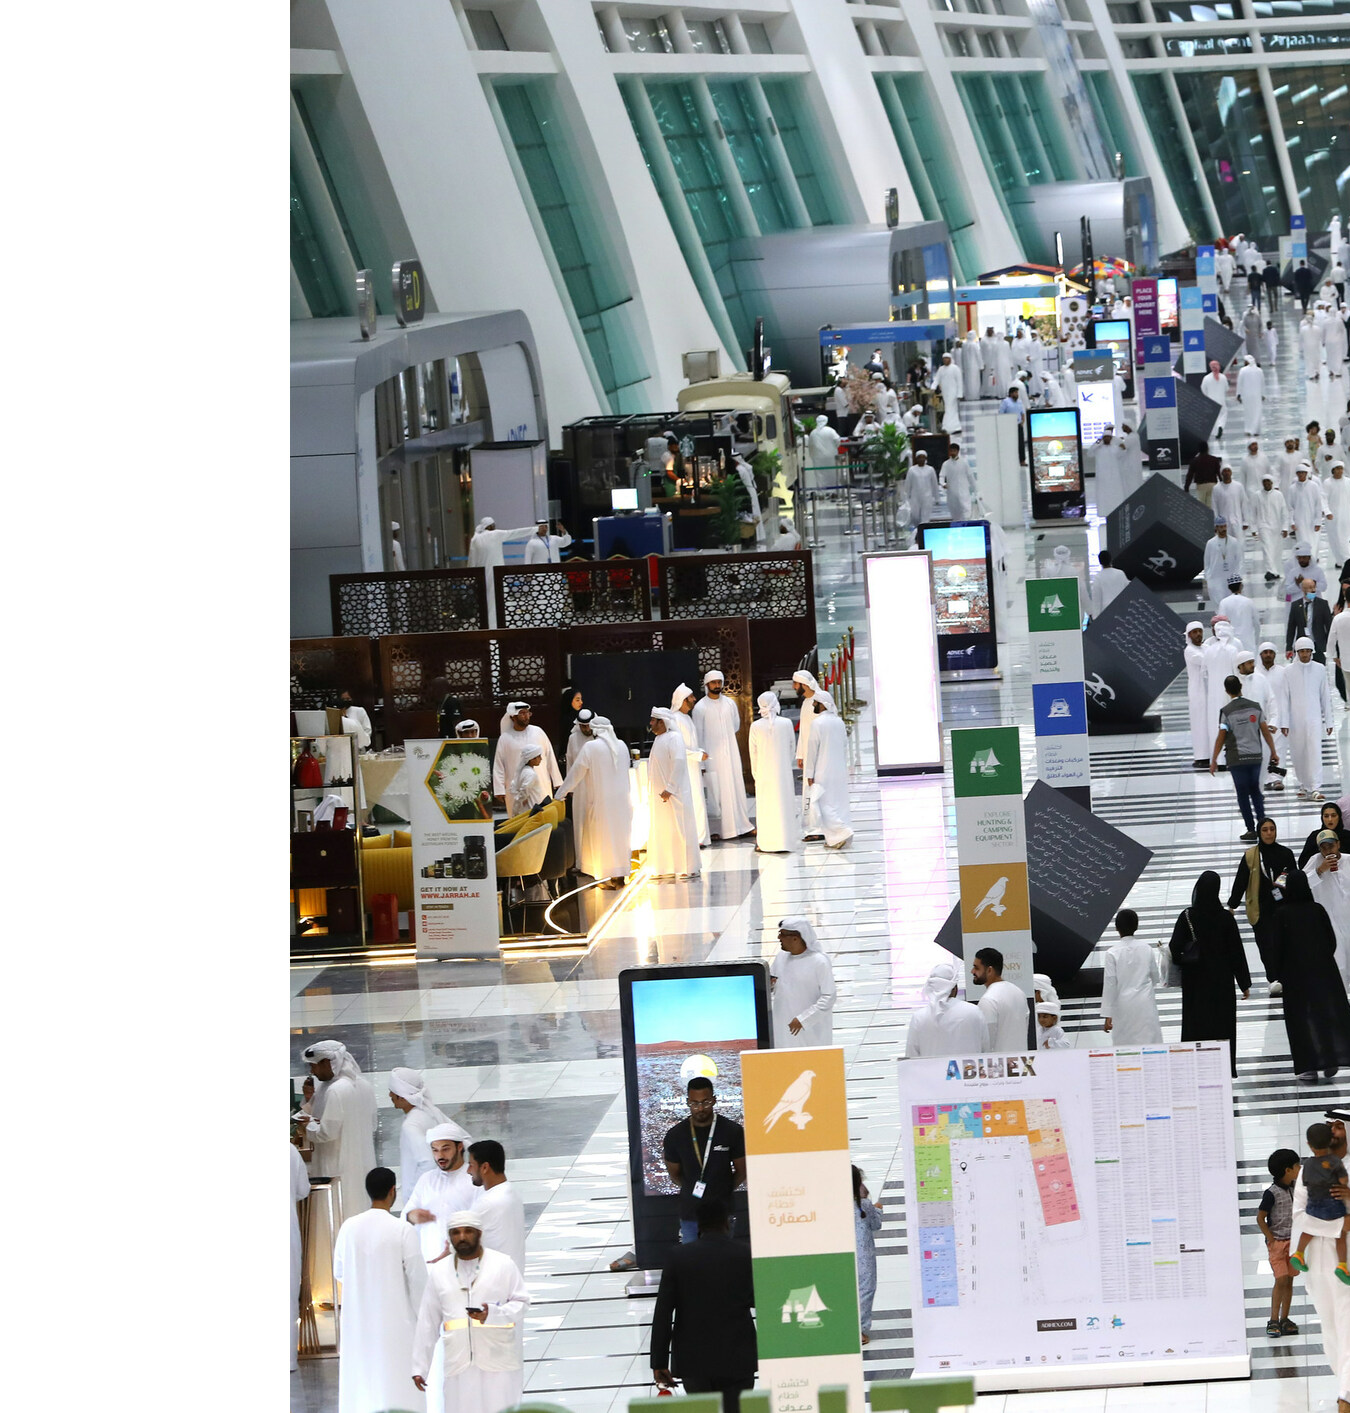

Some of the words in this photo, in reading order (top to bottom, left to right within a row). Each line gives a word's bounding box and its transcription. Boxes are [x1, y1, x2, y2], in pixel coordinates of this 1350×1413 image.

[984, 810, 1012, 818] EXPLORE
[975, 834, 1012, 842] EQUIPMENT
[769, 1211, 816, 1227] الصقارة
